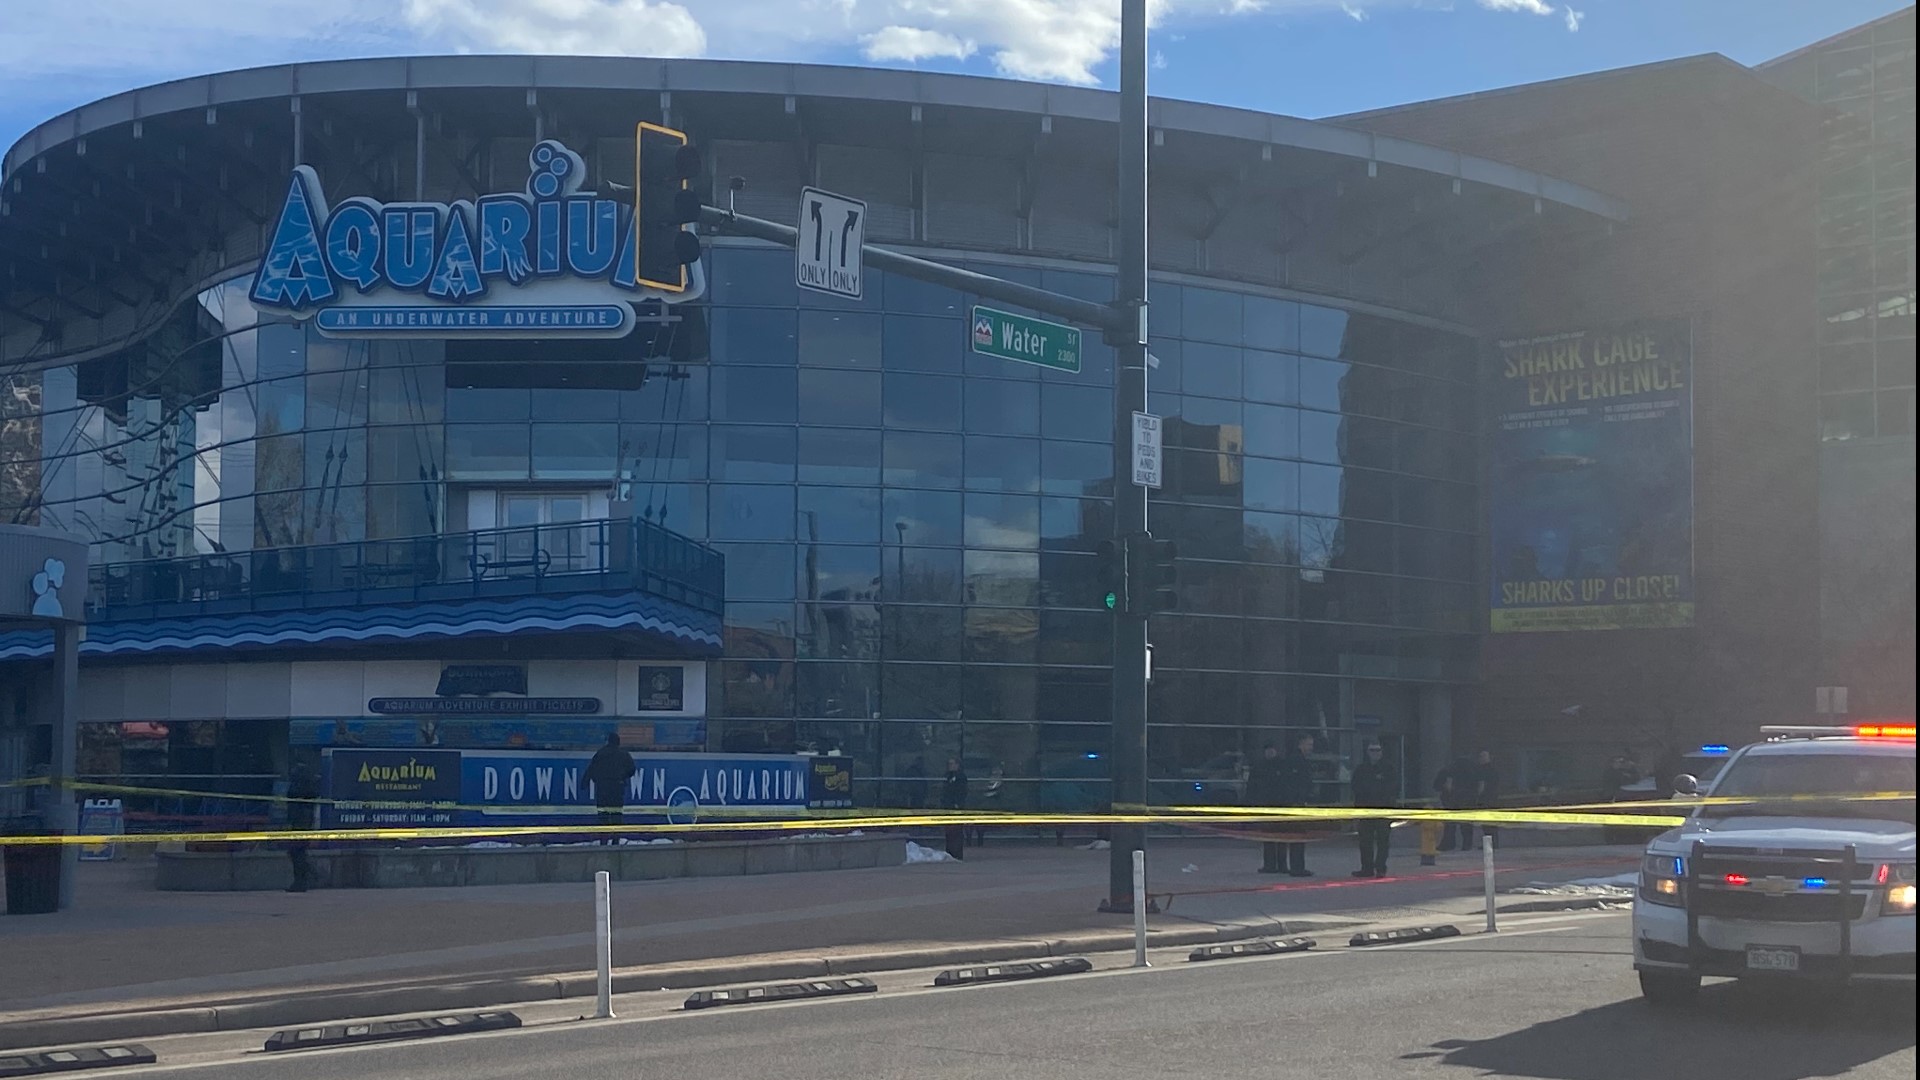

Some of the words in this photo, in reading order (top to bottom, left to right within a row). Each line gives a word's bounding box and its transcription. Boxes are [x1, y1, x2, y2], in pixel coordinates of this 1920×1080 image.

[251, 172, 694, 307] AQUARIU
[800, 263, 826, 285] ONLY
[832, 270, 858, 292] ONLY
[336, 312, 358, 325] AN
[372, 312, 489, 325] UNDERWATER
[503, 311, 607, 325] ADVENTURE
[1001, 321, 1048, 357] Water
[1057, 349, 1076, 364] 2300
[1503, 340, 1585, 378] SHARK
[1593, 332, 1659, 367] CAGE
[1528, 358, 1684, 406] EXPERIENCE
[1142, 432, 1152, 444] TO
[1137, 444, 1156, 458] PEDS
[1139, 458, 1155, 470] AND
[1502, 579, 1575, 604] SHARKS
[1581, 578, 1606, 601] UP
[1613, 575, 1680, 600] CLOSE!
[384, 701, 433, 710] AQUARIUM
[439, 701, 494, 710] ADVENTURE
[500, 701, 537, 710] EXHIBIT
[543, 701, 584, 710] TICKETS
[484, 766, 665, 800] DOWNWN
[700, 769, 805, 805] AQUARIUM
[340, 814, 365, 823] FRIDAY
[432, 814, 450, 823] 10PM
